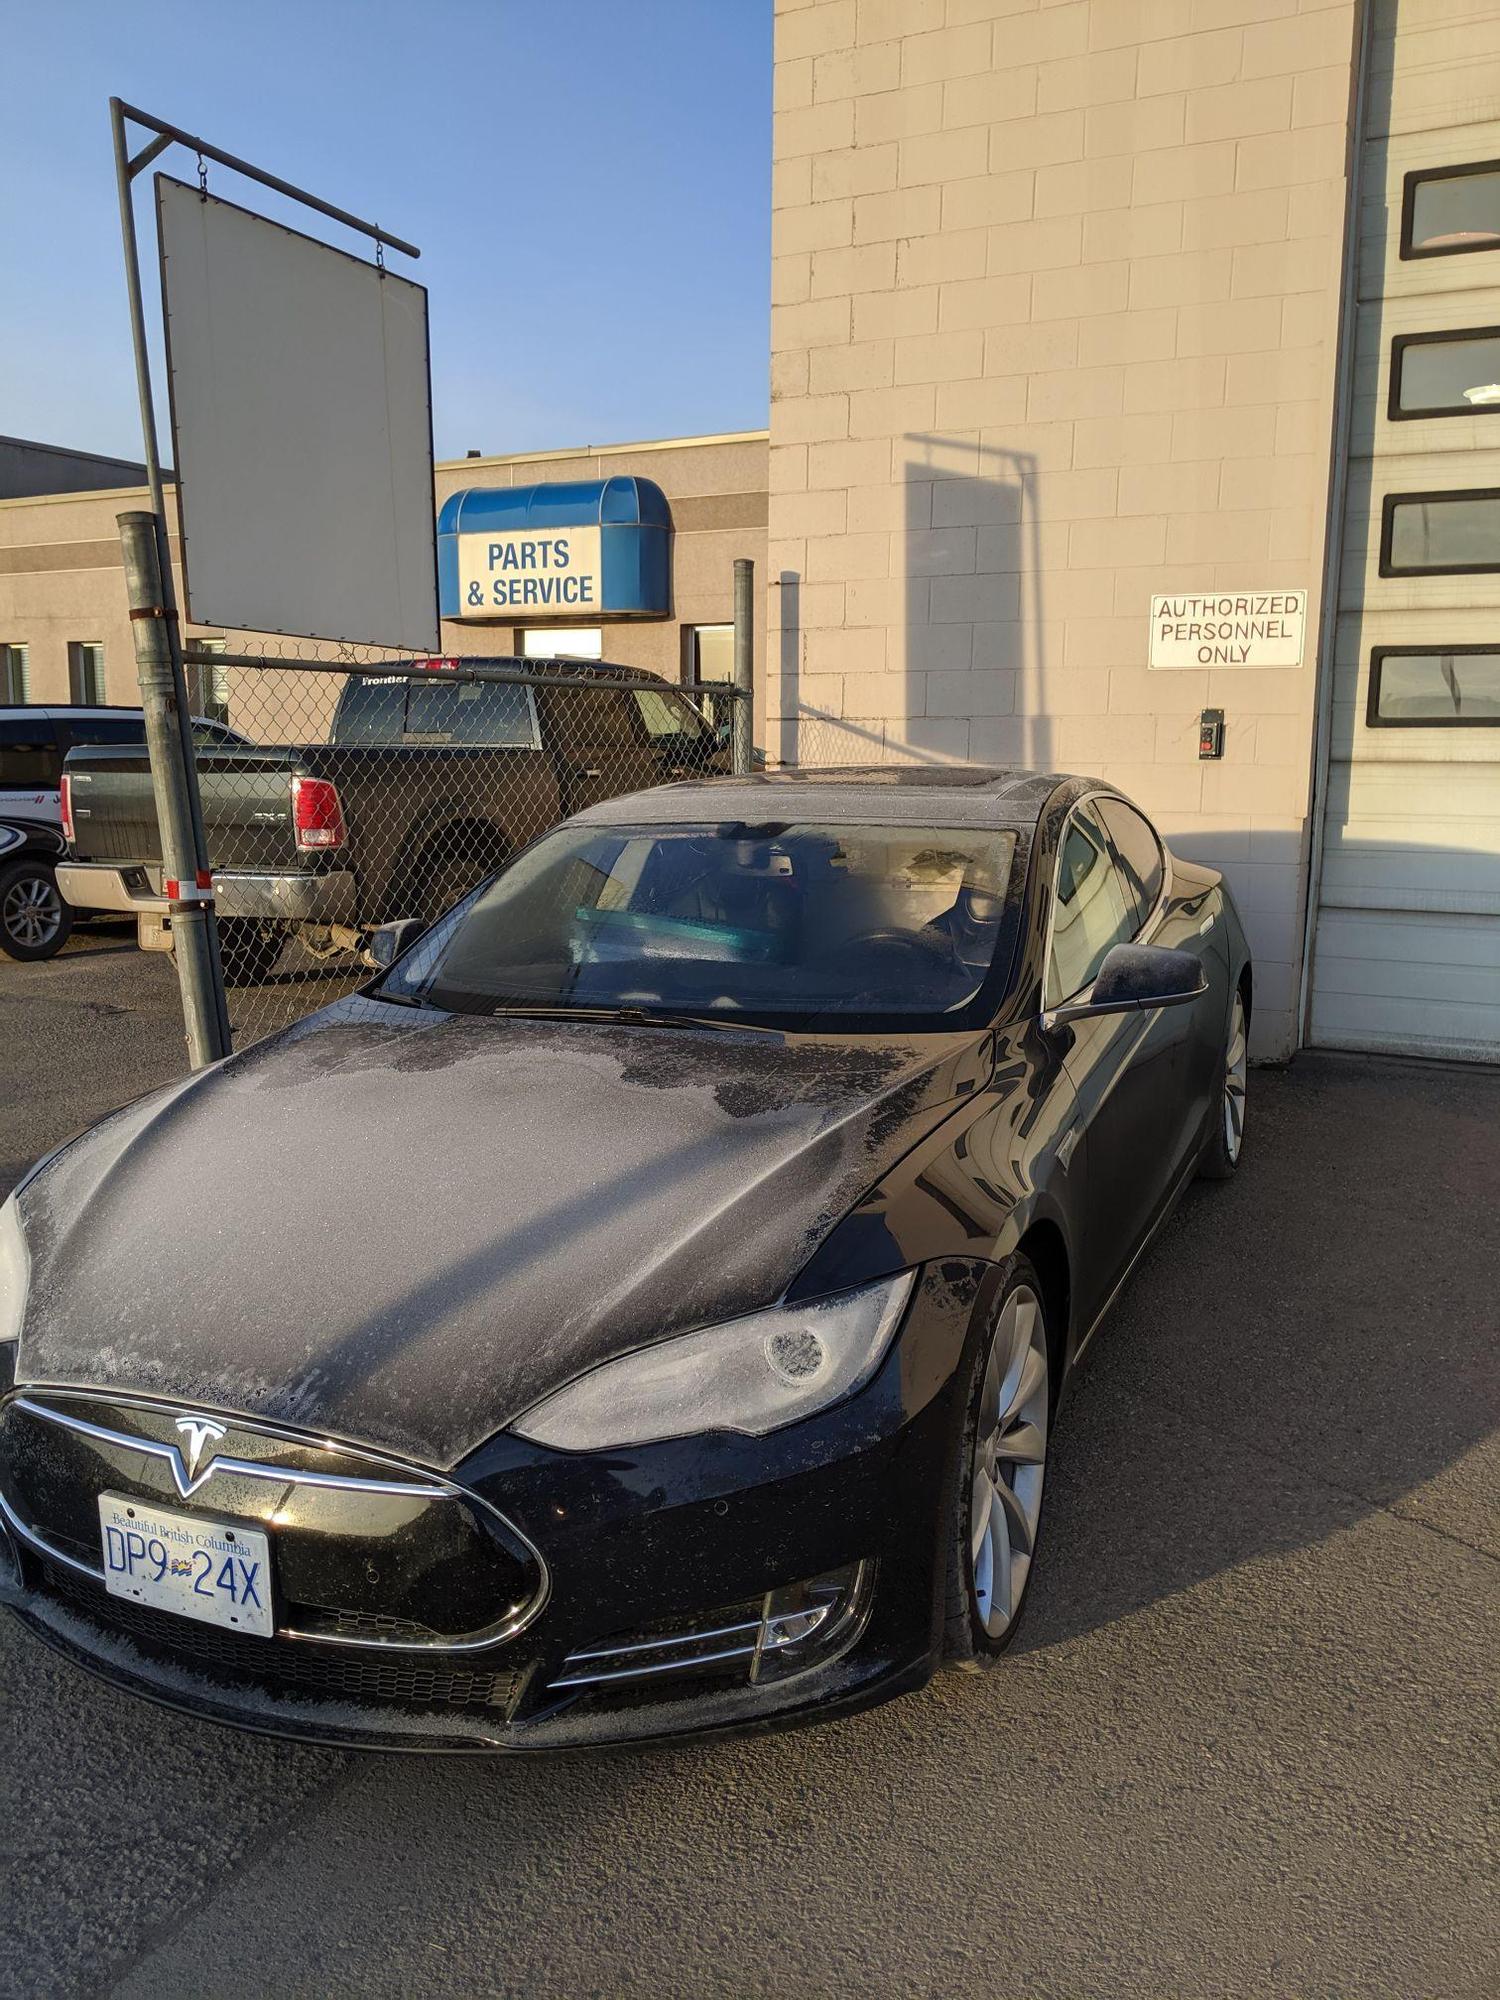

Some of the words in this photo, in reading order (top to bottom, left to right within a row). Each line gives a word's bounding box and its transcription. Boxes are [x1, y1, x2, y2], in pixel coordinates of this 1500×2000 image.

[488, 539, 570, 571] PARTS
[467, 581, 484, 607] &
[493, 575, 593, 606] SERVICE
[1158, 596, 1299, 618] AUTHORIZED
[1161, 620, 1293, 641] PERSONNEL
[1197, 644, 1252, 664] ONLY
[362, 675, 409, 686] Frontier
[113, 1512, 157, 1534] Beautiful
[160, 1525, 194, 1545] British
[196, 1534, 251, 1557] Columbia
